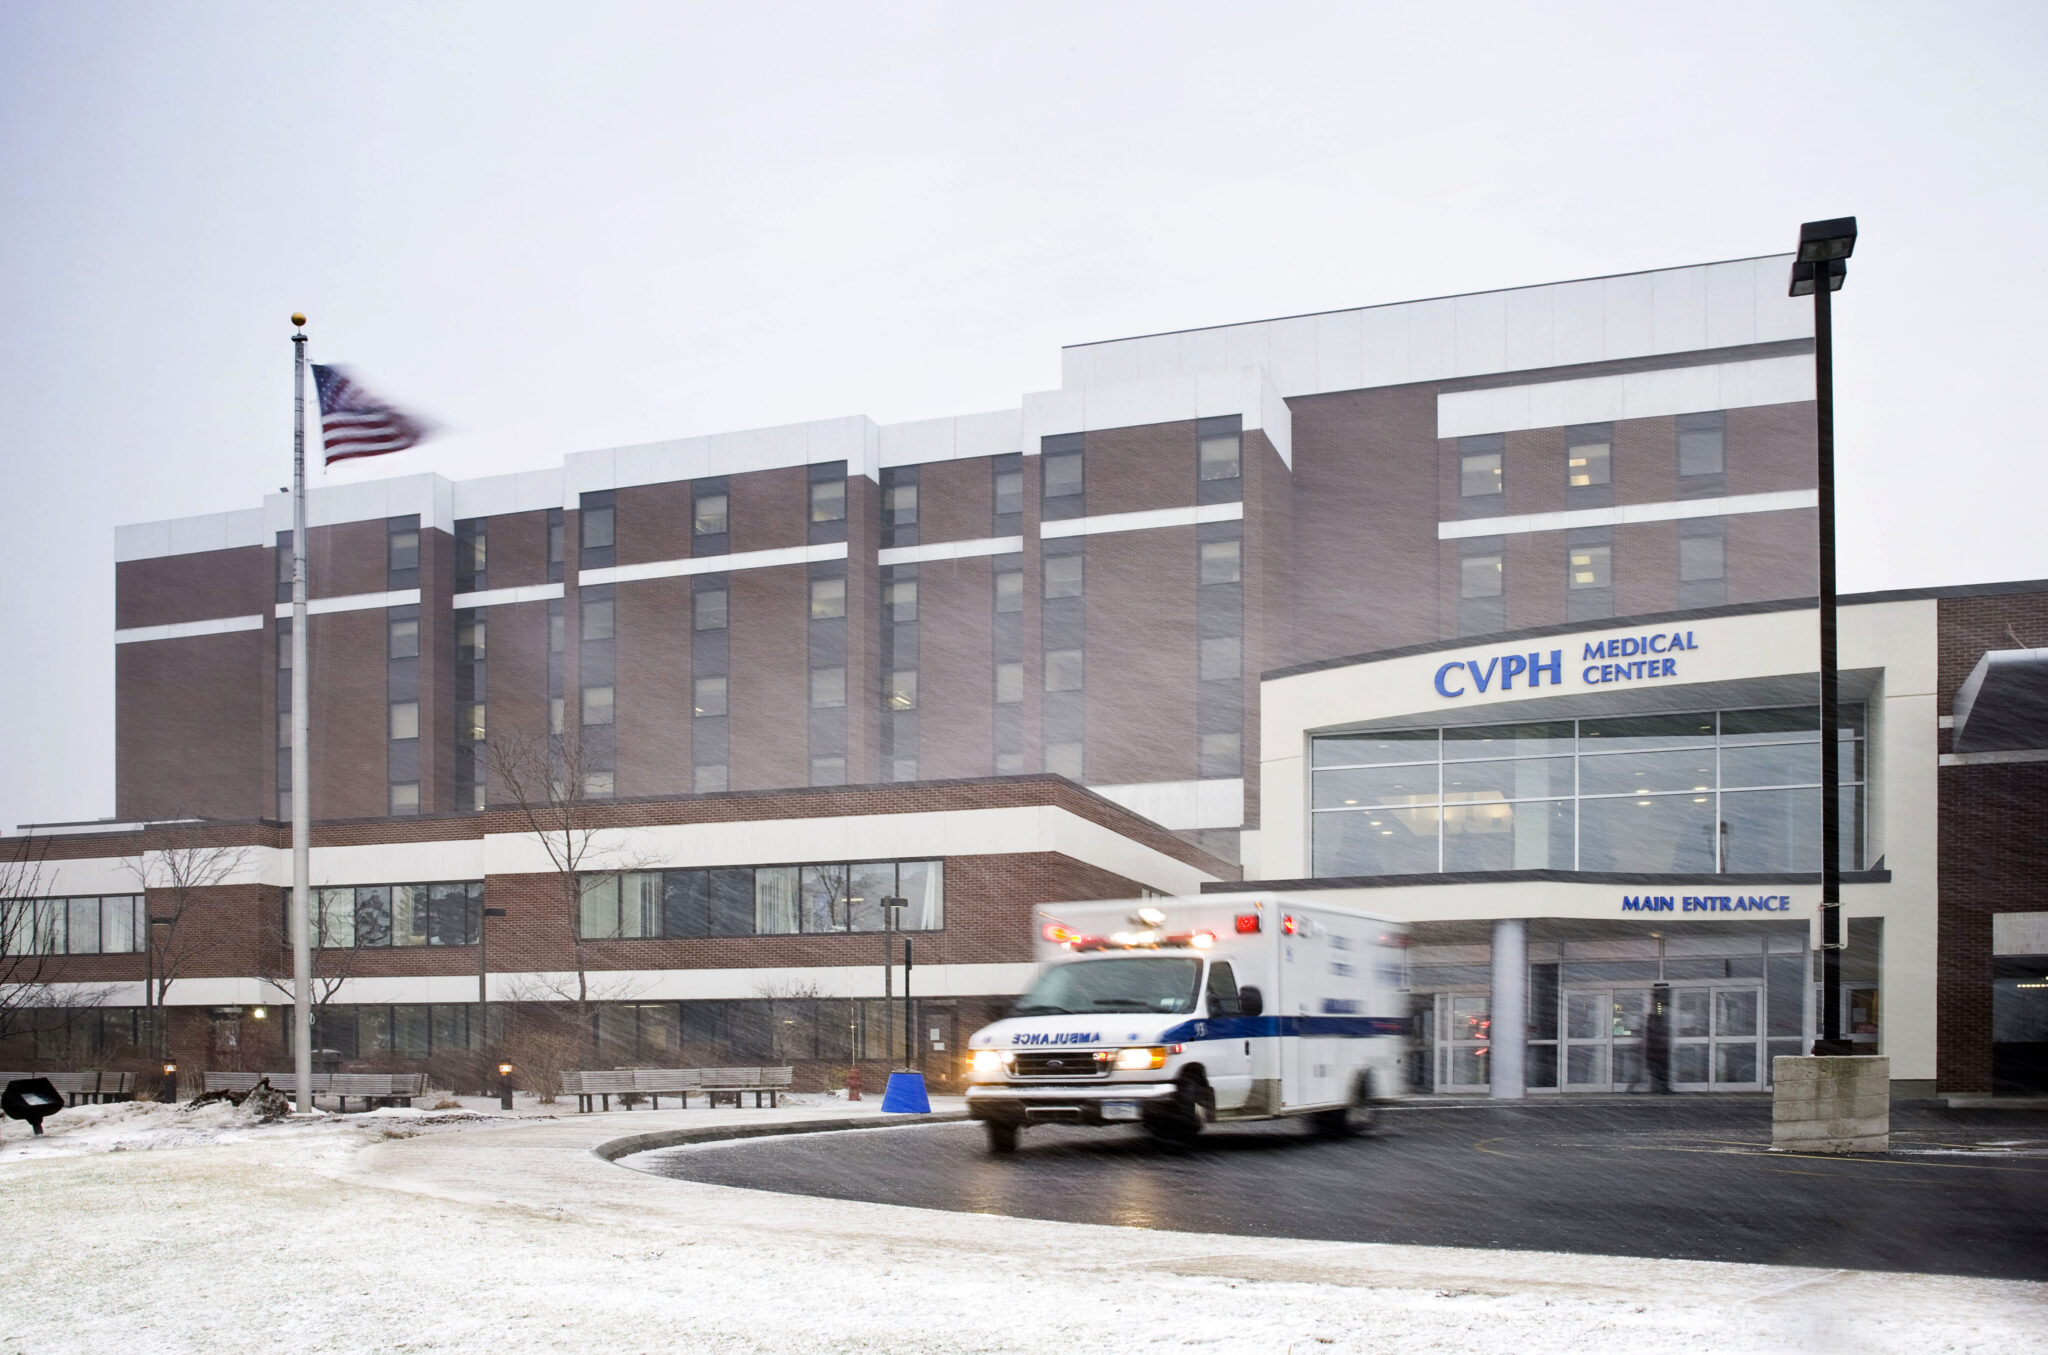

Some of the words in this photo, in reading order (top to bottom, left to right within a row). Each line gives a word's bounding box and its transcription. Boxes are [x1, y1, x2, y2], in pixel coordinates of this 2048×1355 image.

[1582, 631, 1698, 661] MEDICAL
[1434, 650, 1562, 698] CVPH
[1582, 658, 1677, 685] CENTER
[1622, 896, 1675, 911] MAIN
[1682, 895, 1790, 912] ENTRANCE
